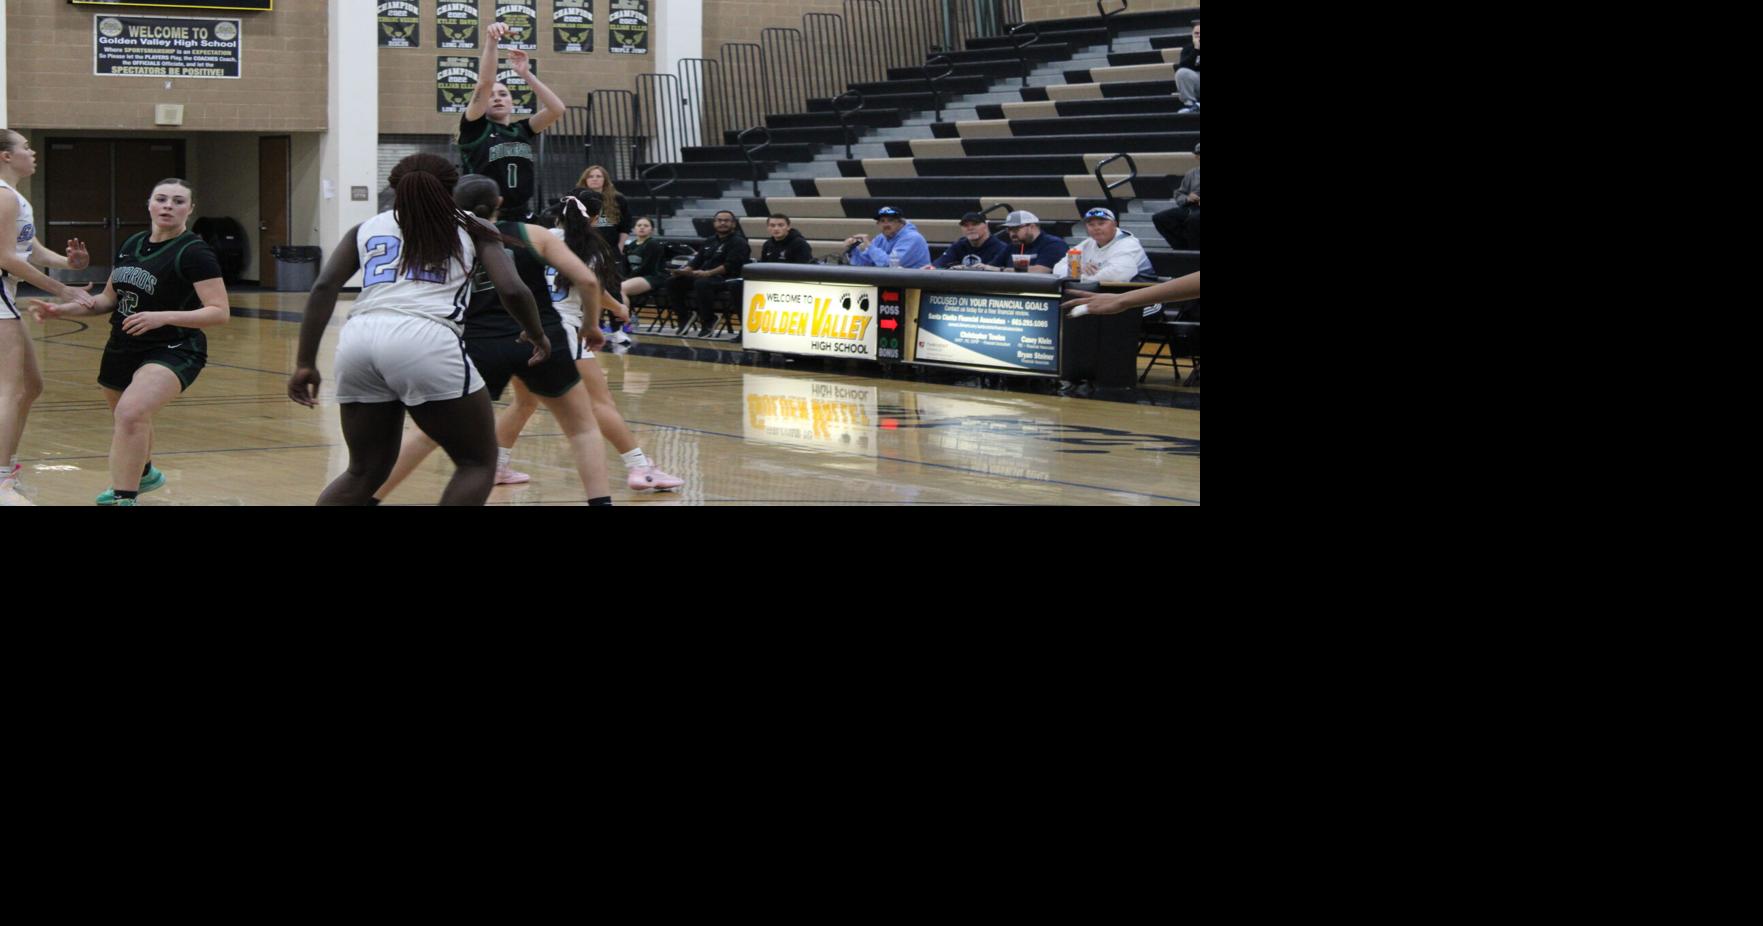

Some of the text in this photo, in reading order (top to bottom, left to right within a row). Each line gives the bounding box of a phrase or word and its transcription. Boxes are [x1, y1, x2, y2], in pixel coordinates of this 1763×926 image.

[437, 3, 478, 17] CHAMPION
[553, 7, 593, 21] CHAMPION
[609, 10, 648, 24] CHAMPION
[128, 25, 189, 39] WELCOME
[192, 28, 208, 39] TO
[99, 37, 236, 48] Golden Valley High School
[111, 66, 224, 76] SPECTATORS BE POSITIVE!
[437, 67, 478, 82] CHAMPION
[507, 163, 518, 188] 1
[766, 292, 813, 304] WELCOME TO
[929, 295, 1049, 311] FOCUSED ON YOUR FINANCIAL GOALS
[880, 304, 900, 315] POSS
[747, 293, 872, 341] GOLDEN VALLEY
[811, 341, 868, 354] HIGH SCHOOL
[878, 348, 899, 358] BONUS
